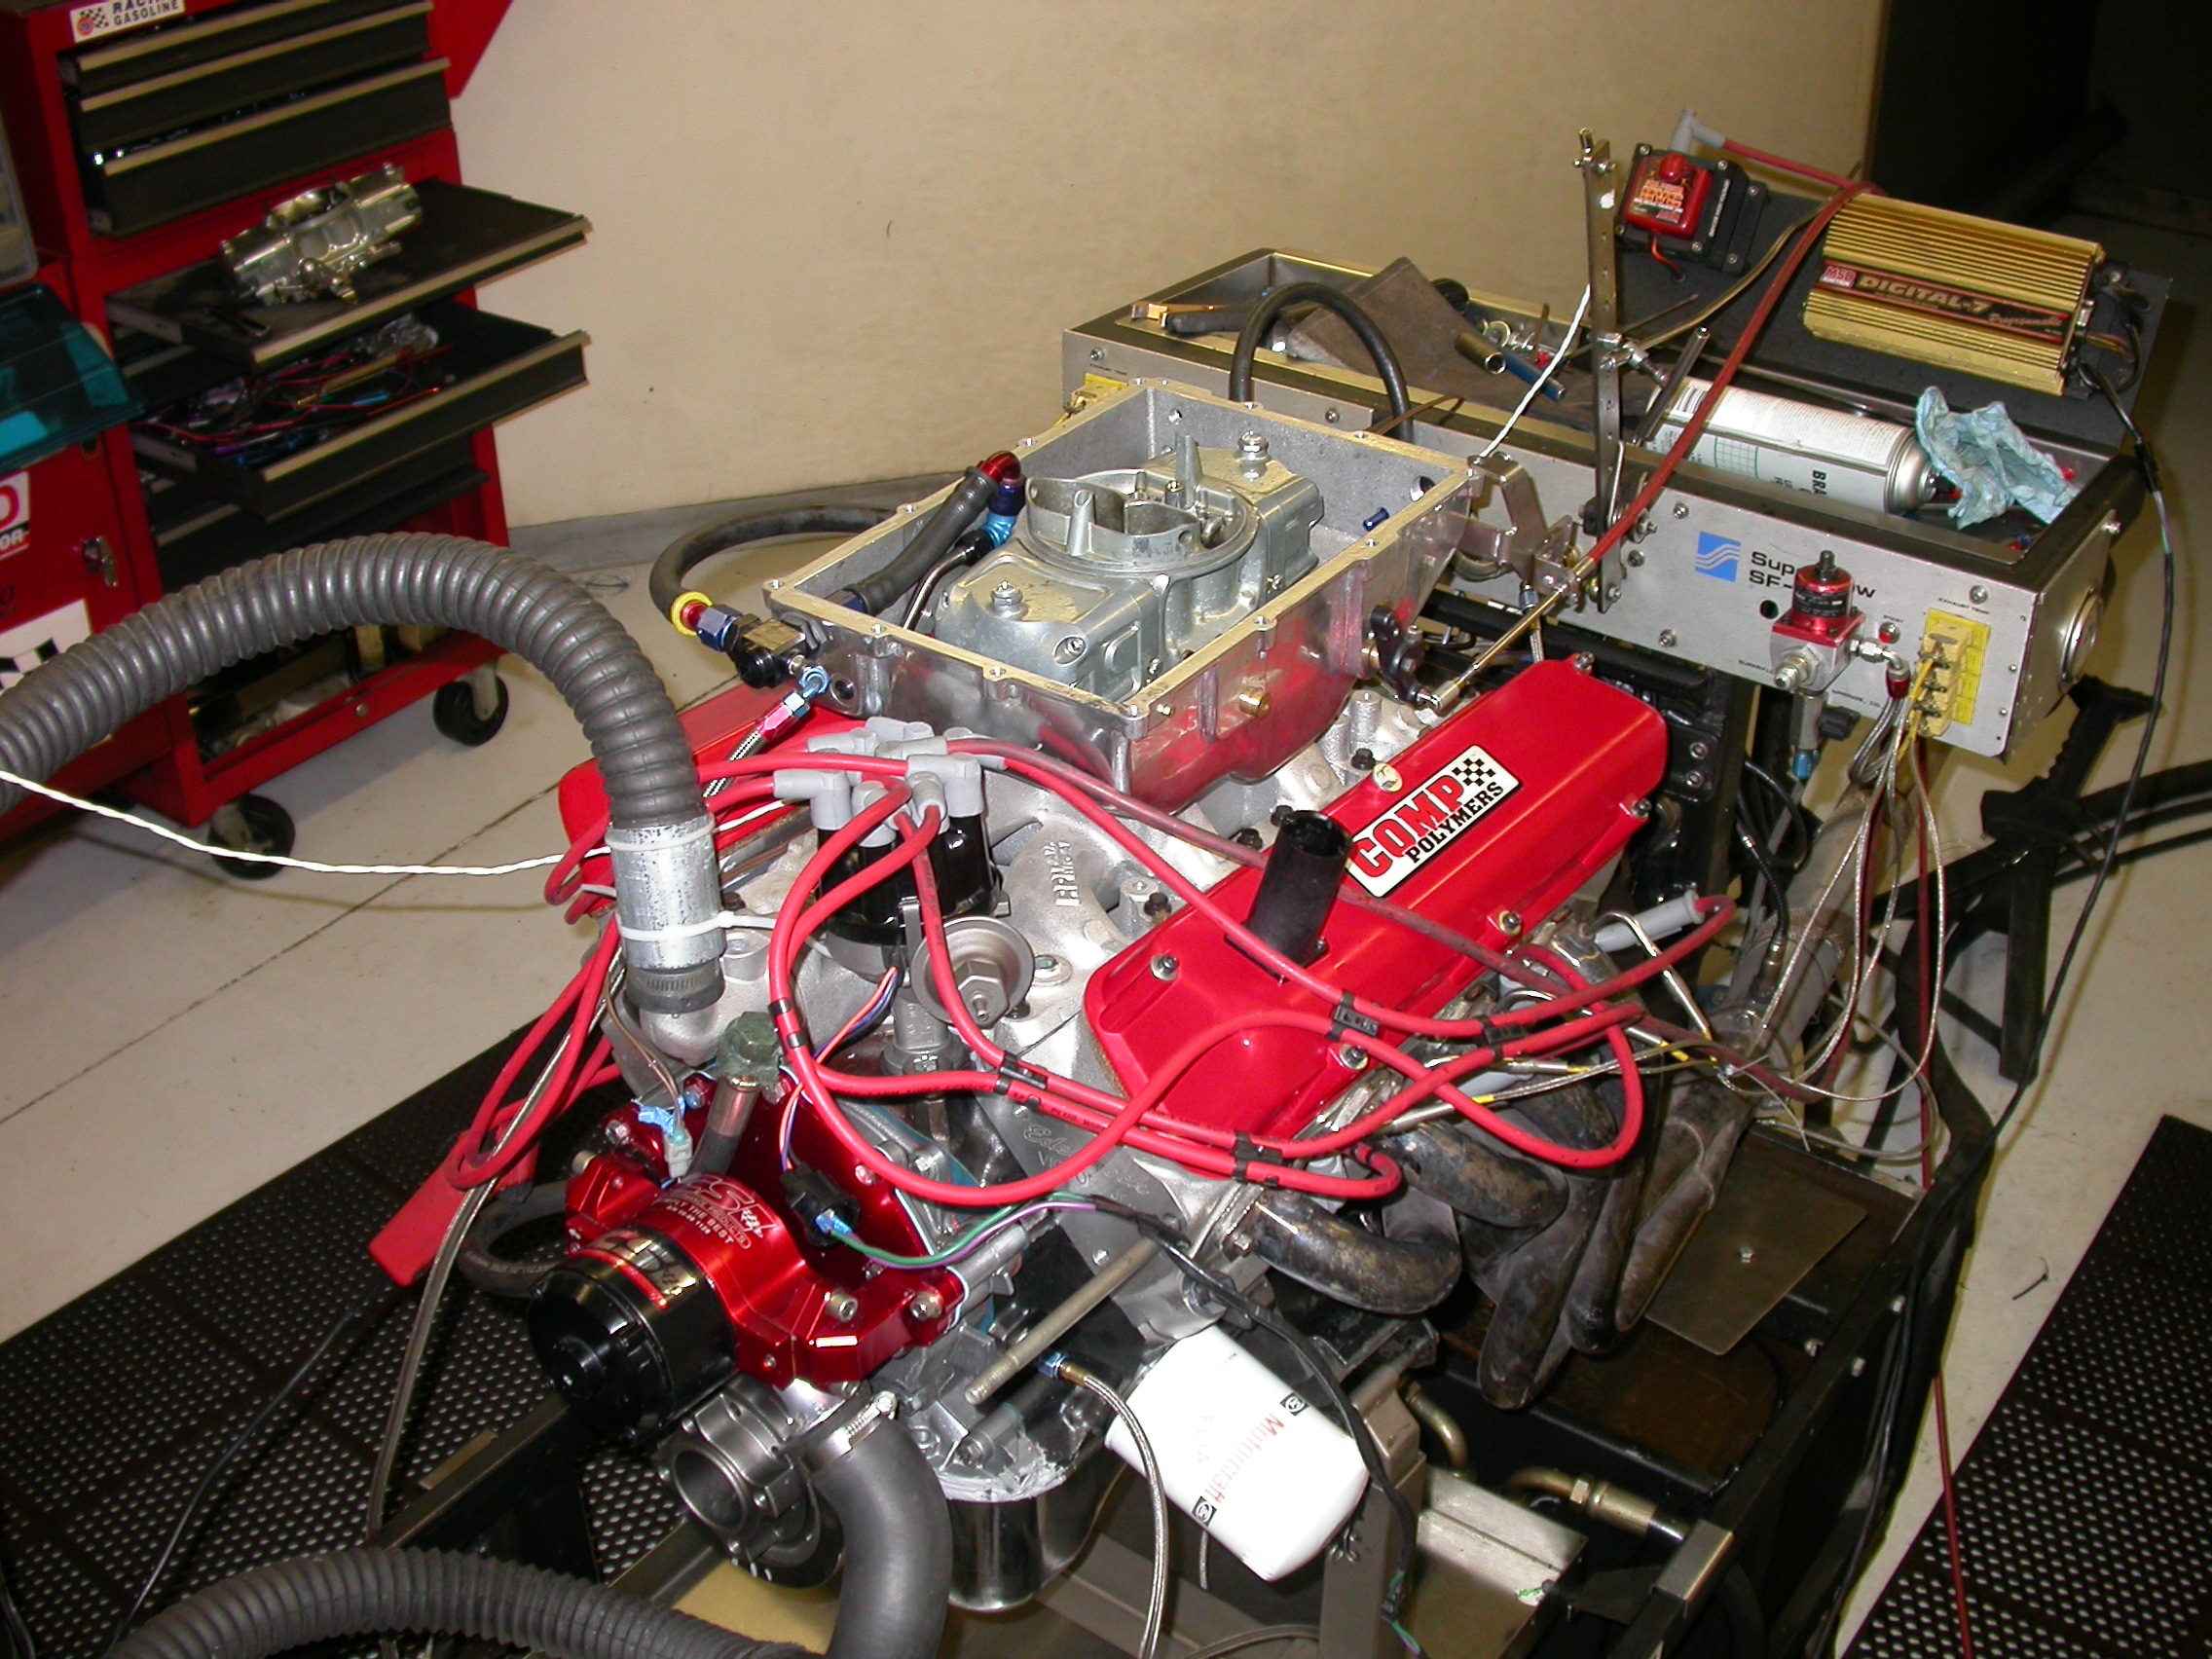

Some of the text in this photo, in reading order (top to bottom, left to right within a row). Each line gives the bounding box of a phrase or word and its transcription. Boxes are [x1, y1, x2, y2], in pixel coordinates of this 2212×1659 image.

[114, 1, 179, 25] GASOLINE
[1824, 265, 1857, 282] MSD
[1858, 274, 1992, 315] DIGITAL-7
[1812, 469, 1827, 497] BRA
[1749, 570, 1793, 590] SF-
[1349, 774, 1464, 878] COMP
[1403, 781, 1505, 864] POLYMERS
[707, 1217, 735, 1245] BEST
[1203, 1412, 1286, 1504] Motorcraft
